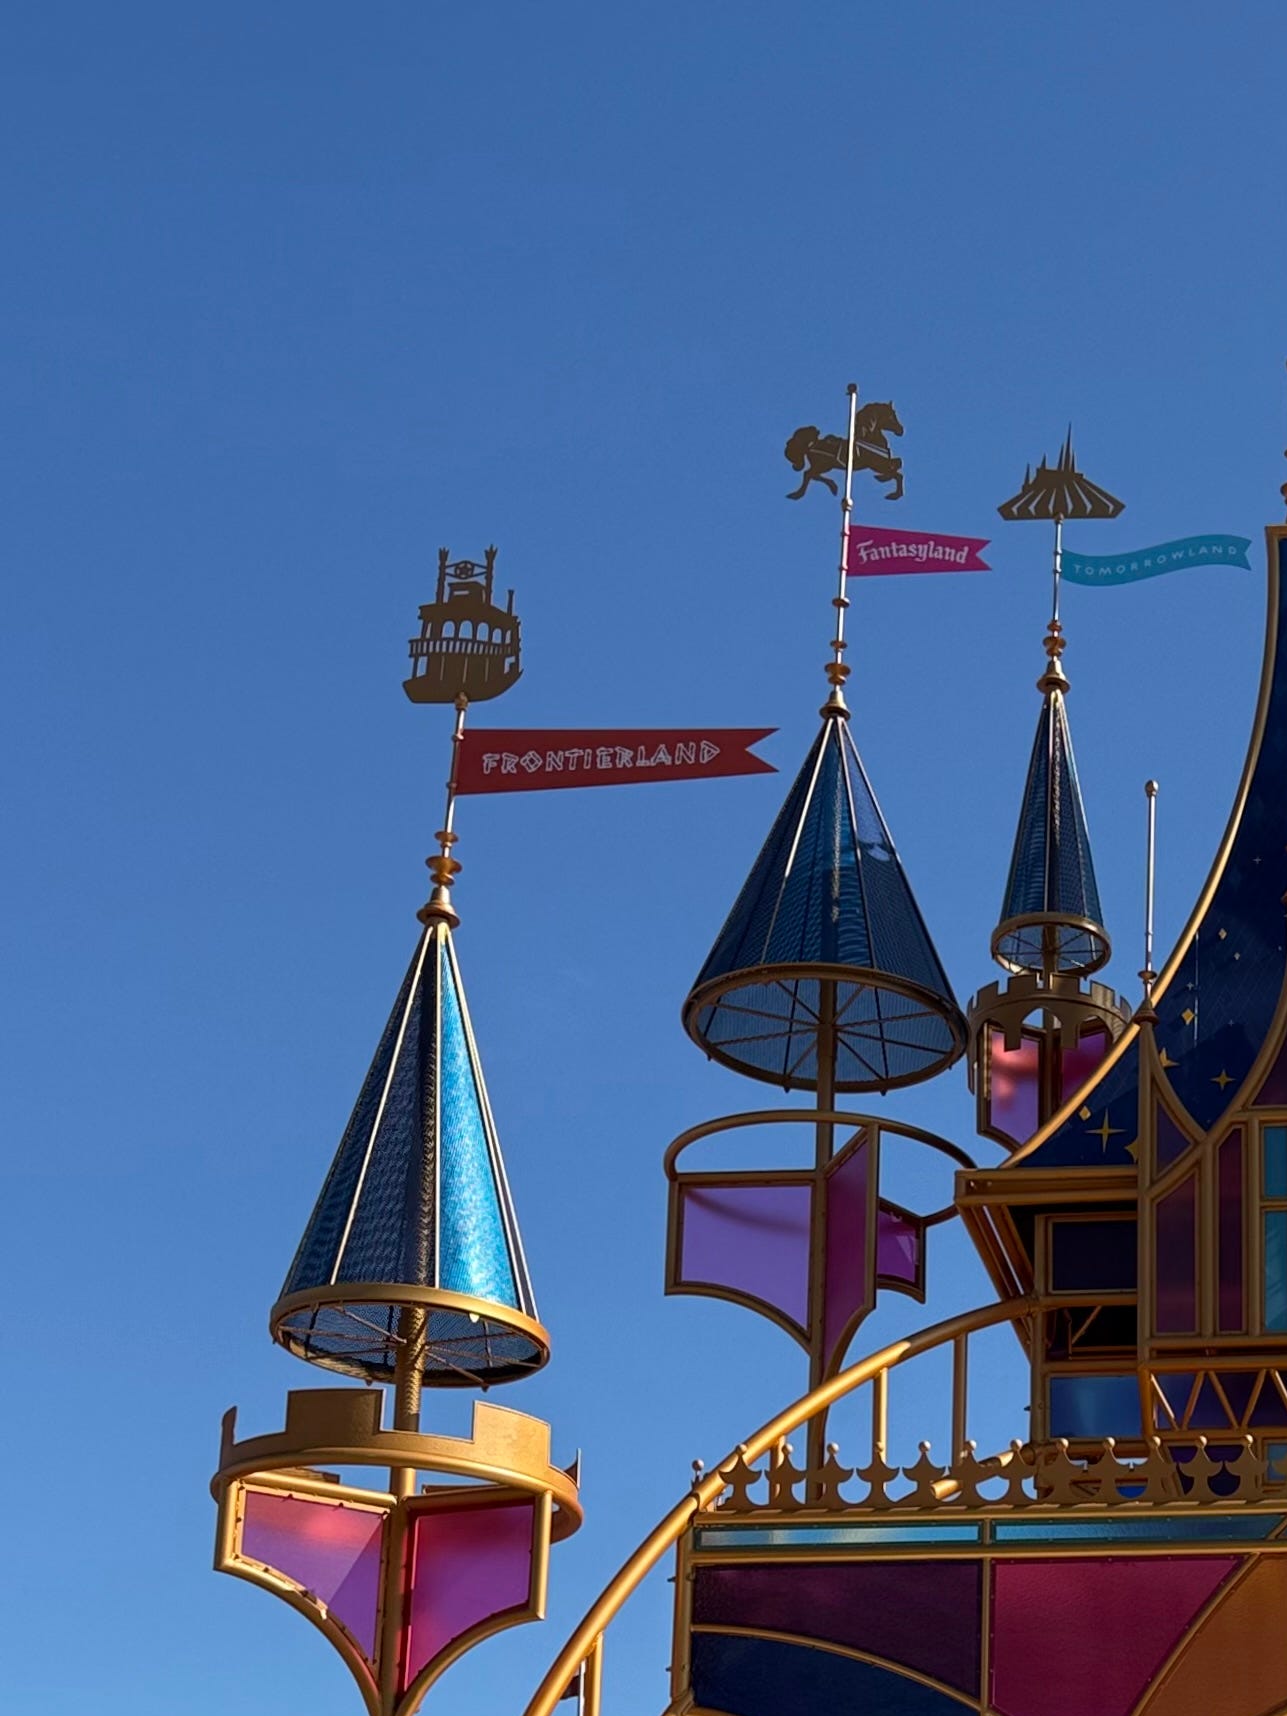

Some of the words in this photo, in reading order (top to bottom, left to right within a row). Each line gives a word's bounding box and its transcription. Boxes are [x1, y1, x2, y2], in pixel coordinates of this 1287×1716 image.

[855, 539, 970, 565] Fantasyland
[1073, 544, 1238, 576] TOMORROWLAND
[482, 739, 721, 775] FRONTIERLAND
